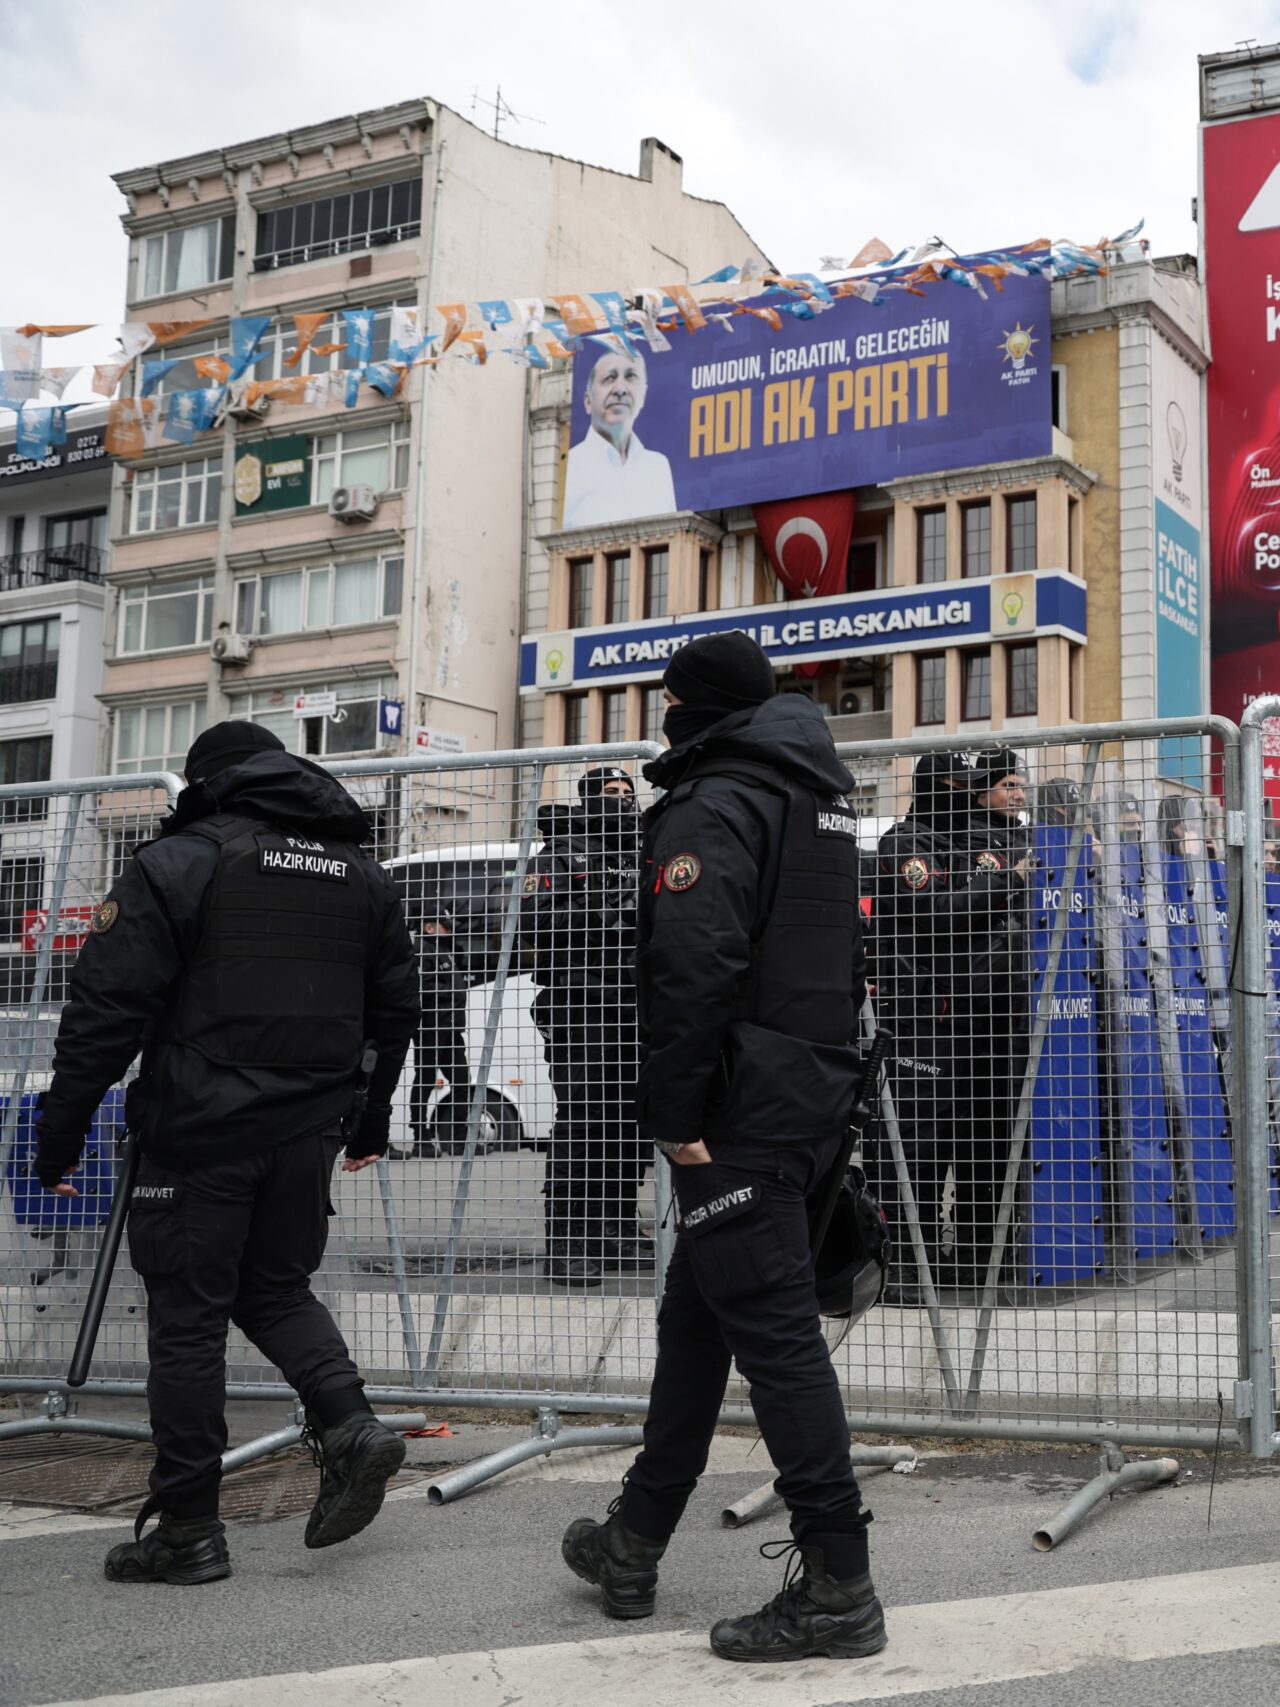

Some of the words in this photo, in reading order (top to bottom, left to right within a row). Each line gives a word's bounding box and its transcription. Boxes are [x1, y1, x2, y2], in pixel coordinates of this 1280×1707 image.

[691, 354, 765, 391] UMUDUN,
[770, 338, 851, 377] İCRAATIN,
[855, 318, 950, 360] GELECEĞİN
[1001, 371, 1013, 381] AK
[689, 387, 752, 458] ADI
[763, 375, 816, 446] AK
[827, 352, 949, 435] PARTİ
[1250, 464, 1271, 479] Ön
[1158, 530, 1198, 583] FATİH
[1158, 561, 1198, 617] İLÇE
[588, 643, 622, 668] AK
[624, 635, 690, 663] PARTİ
[760, 620, 815, 648] İLÇE
[819, 599, 972, 640] BAŞKANLIĞI
[817, 811, 844, 831] HAZIR
[263, 850, 304, 870] HAZIR
[305, 855, 348, 877] KUVVET
[1168, 904, 1187, 926] OLİS
[140, 1186, 174, 1199] KUVVET
[707, 1186, 753, 1216] KUVVET
